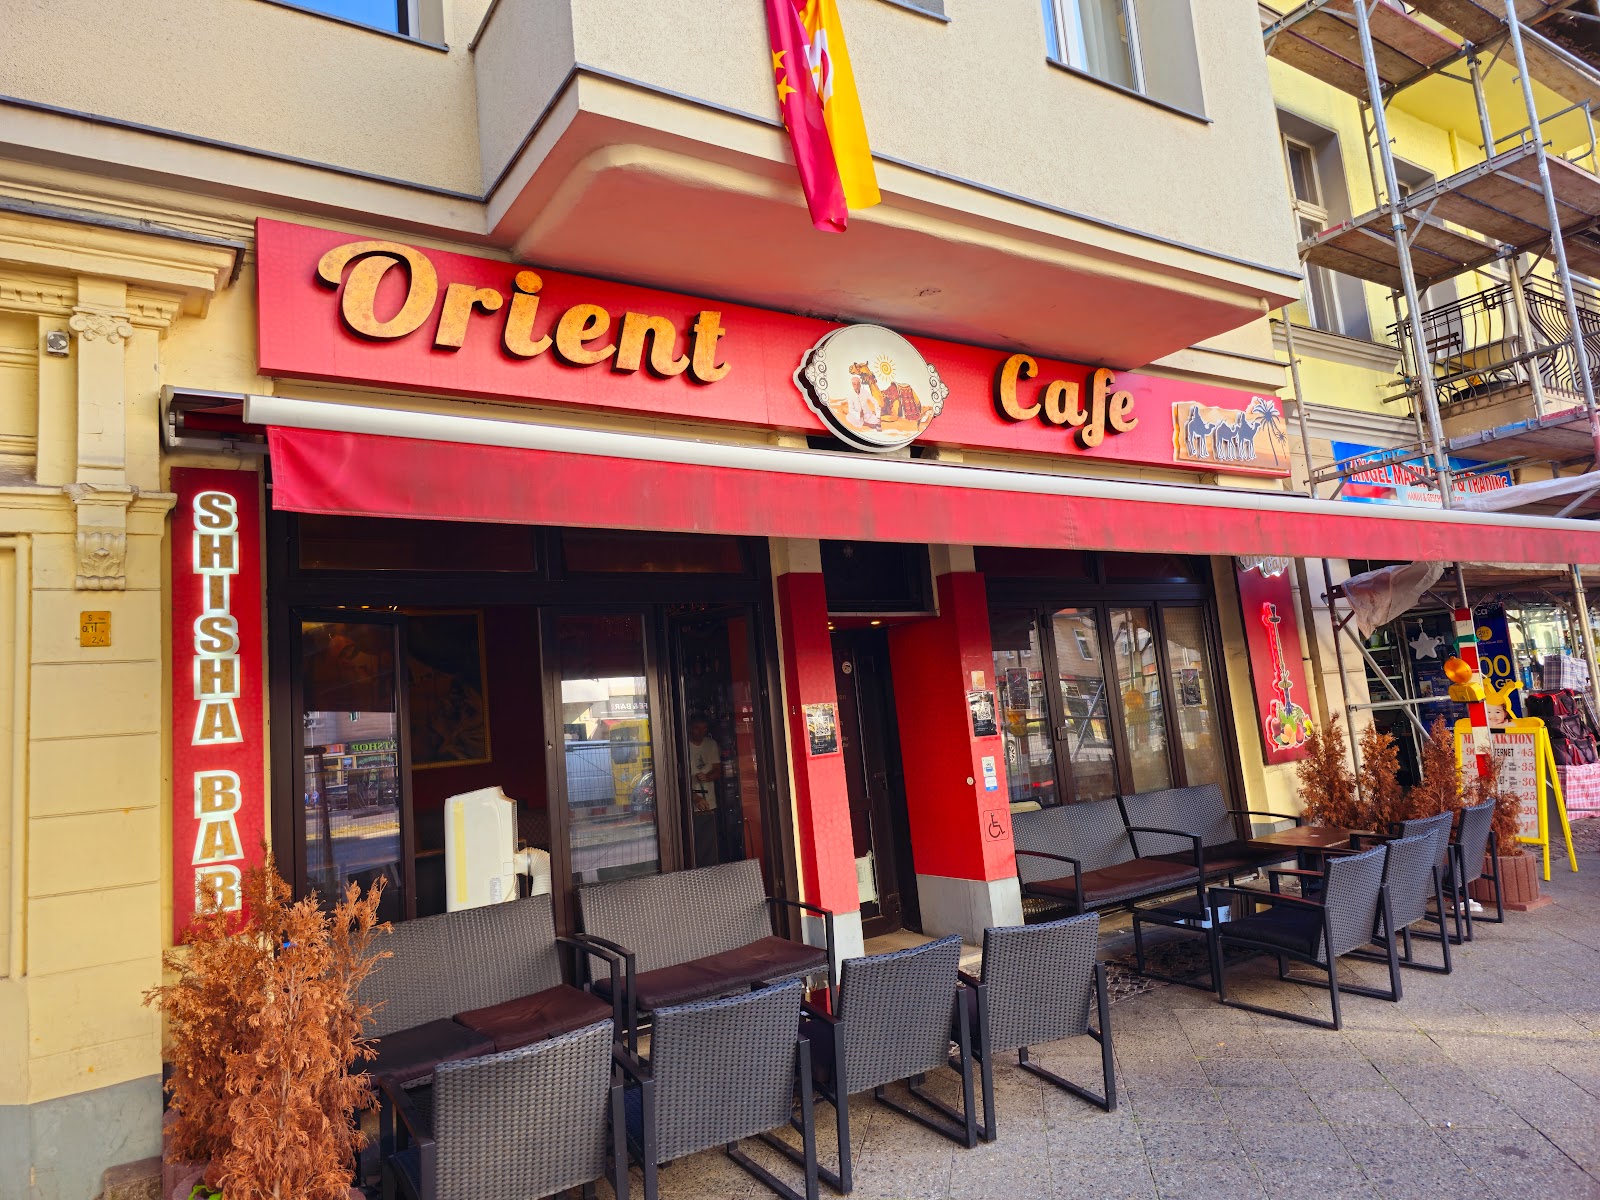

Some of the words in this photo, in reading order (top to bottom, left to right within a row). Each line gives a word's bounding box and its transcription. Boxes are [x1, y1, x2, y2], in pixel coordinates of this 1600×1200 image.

[315, 240, 732, 386] Orient
[996, 353, 1139, 450] Cafe
[1350, 458, 1392, 485] ANGEL
[1464, 472, 1509, 495] TRADING
[192, 490, 244, 746] SHISHA
[1493, 733, 1533, 745] AKTION
[192, 769, 245, 912] BAR
